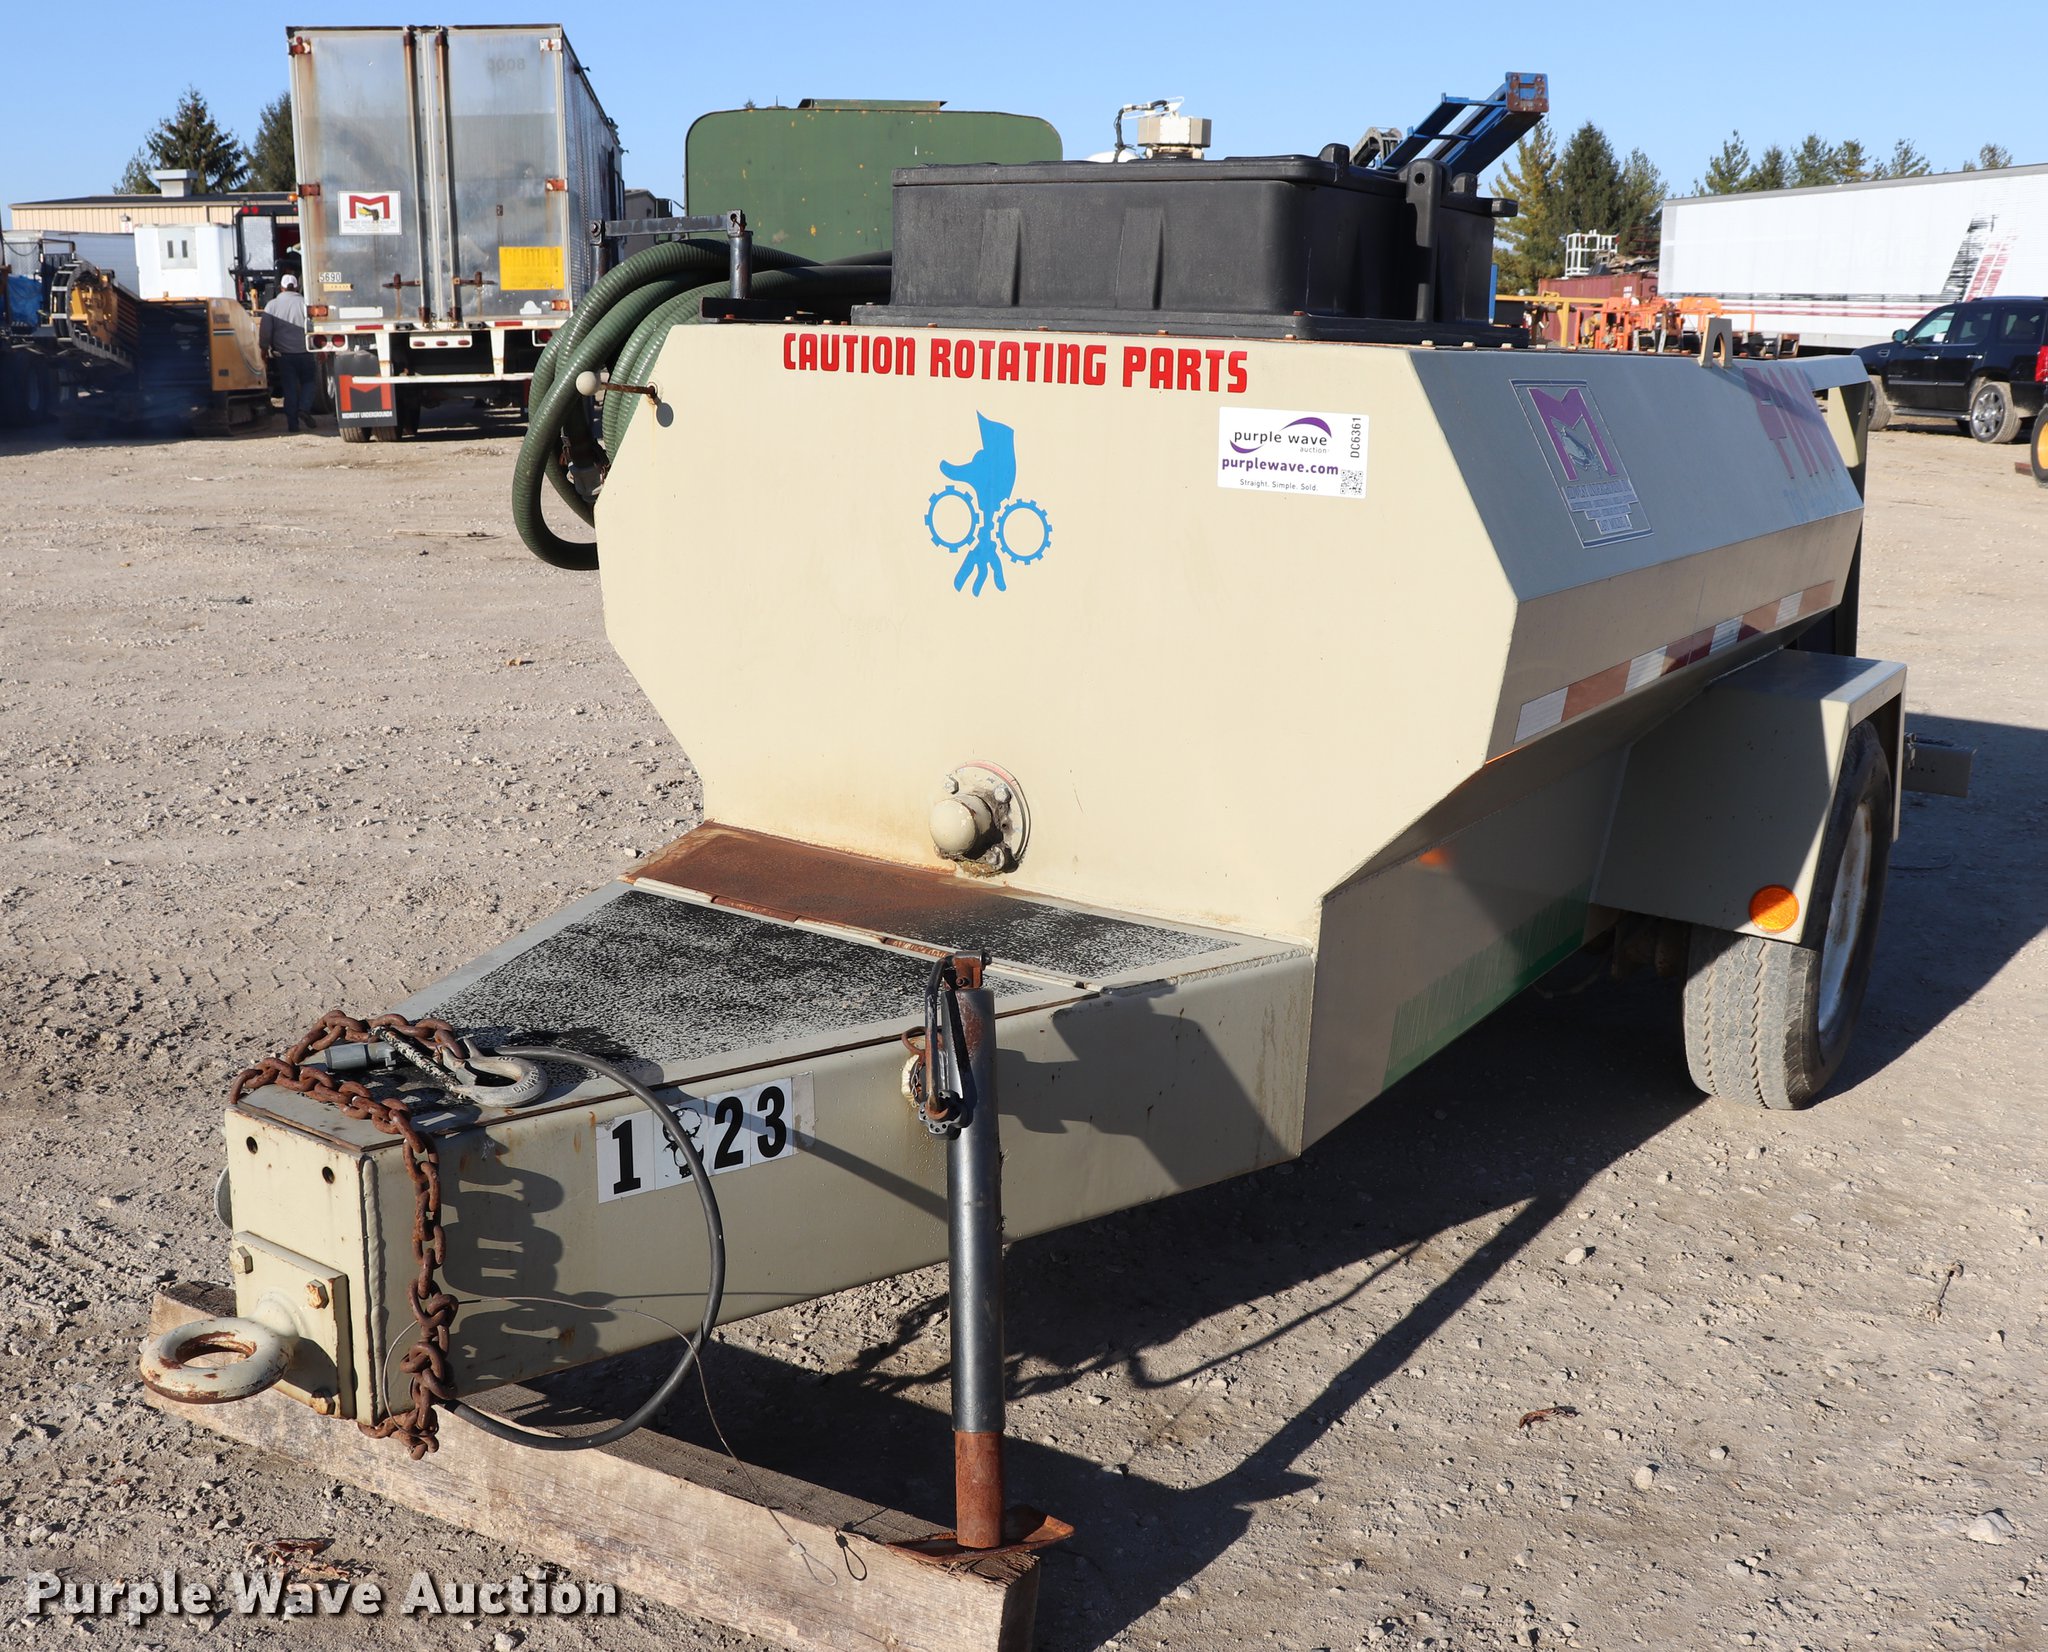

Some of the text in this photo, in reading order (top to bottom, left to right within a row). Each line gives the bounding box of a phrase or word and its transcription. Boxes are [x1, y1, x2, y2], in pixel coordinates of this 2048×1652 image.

[783, 333, 1247, 393] CAUTION ROTATING PARTS
[1234, 431, 1327, 446] purple wave
[1350, 417, 1361, 458] DC6361
[1300, 446, 1327, 454] auction
[1222, 457, 1339, 475] purplewave.com
[1240, 479, 1318, 491] Straight. Simple. Sold.
